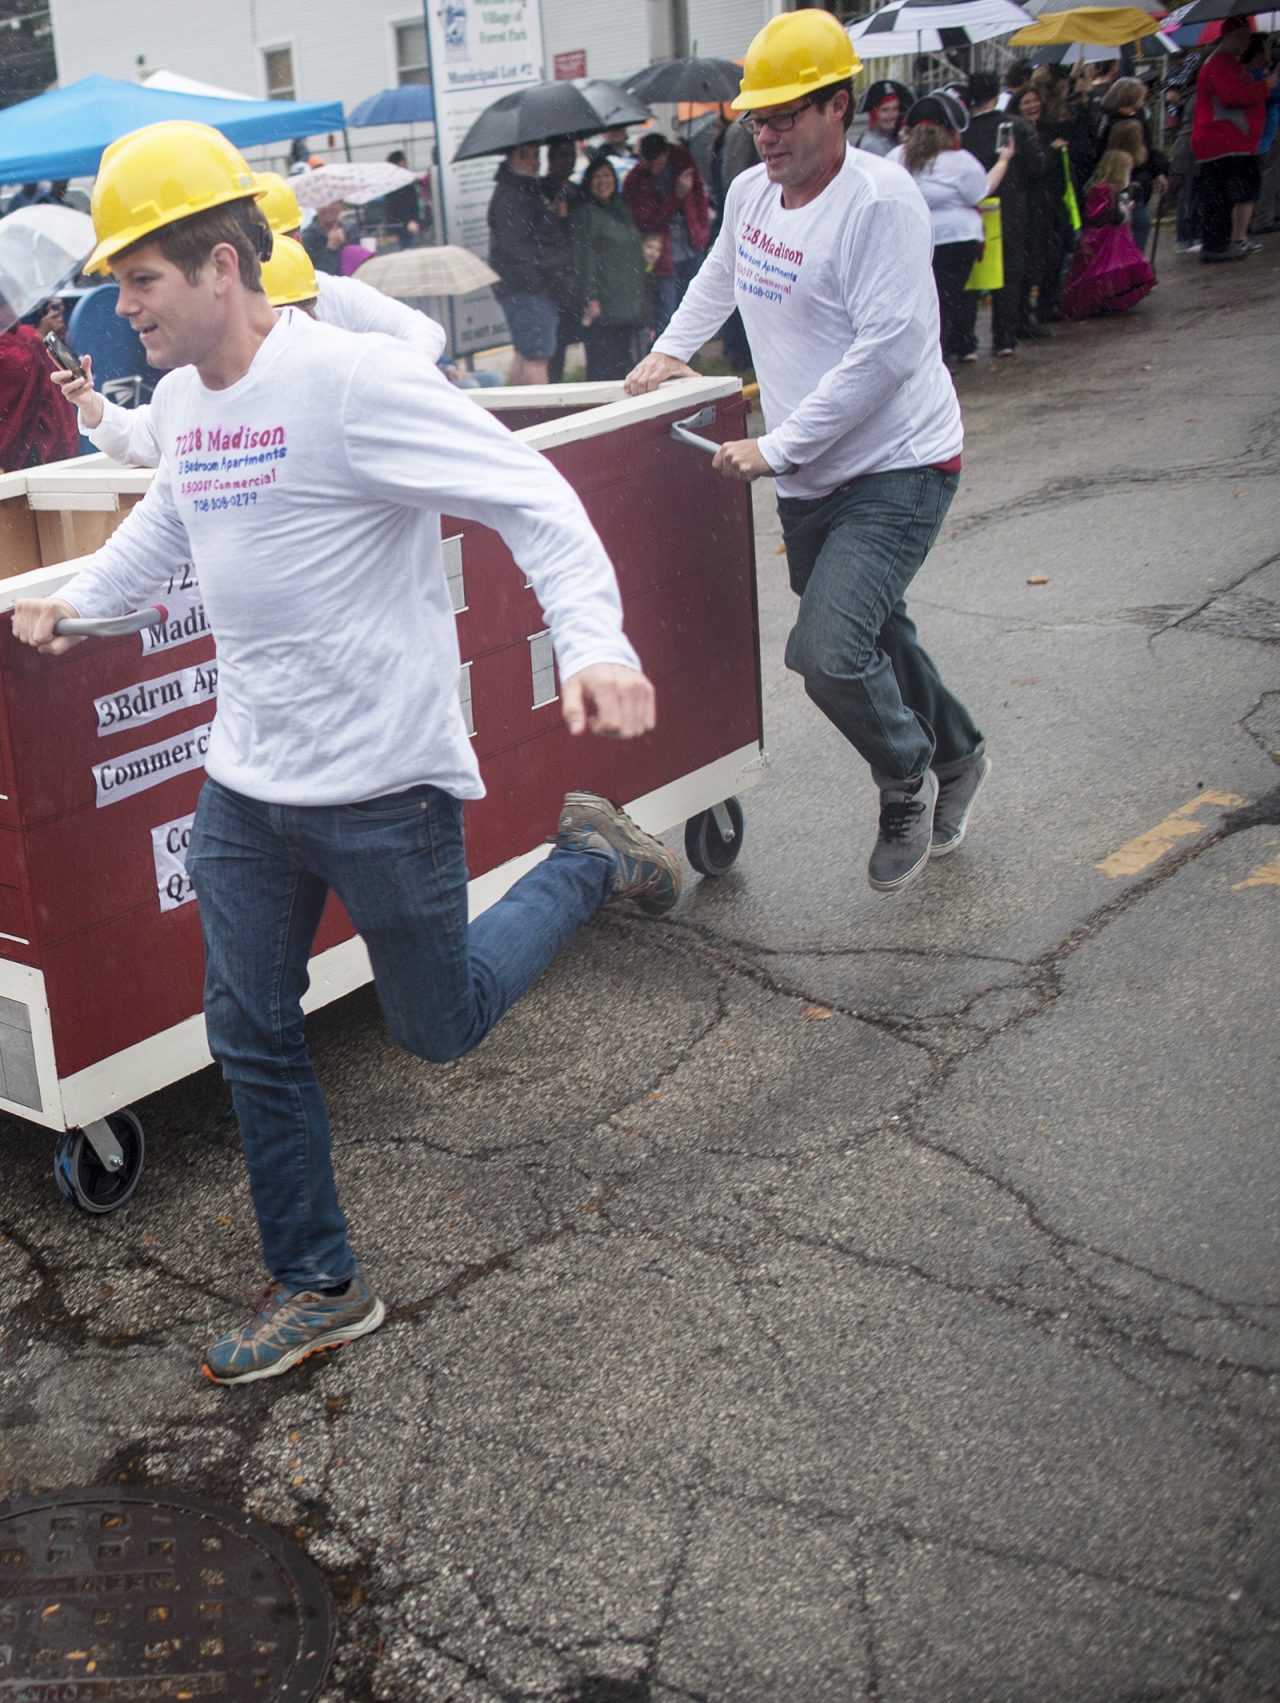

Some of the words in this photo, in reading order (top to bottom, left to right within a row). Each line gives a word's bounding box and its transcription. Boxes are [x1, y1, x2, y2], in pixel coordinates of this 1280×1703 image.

[758, 233, 804, 267] Madison
[175, 428, 202, 457] 7228
[207, 424, 286, 452] Madison
[221, 447, 287, 472] Apartments
[214, 467, 277, 490] Commercial
[150, 604, 211, 649] Madi
[100, 679, 184, 728] 3Bdrm
